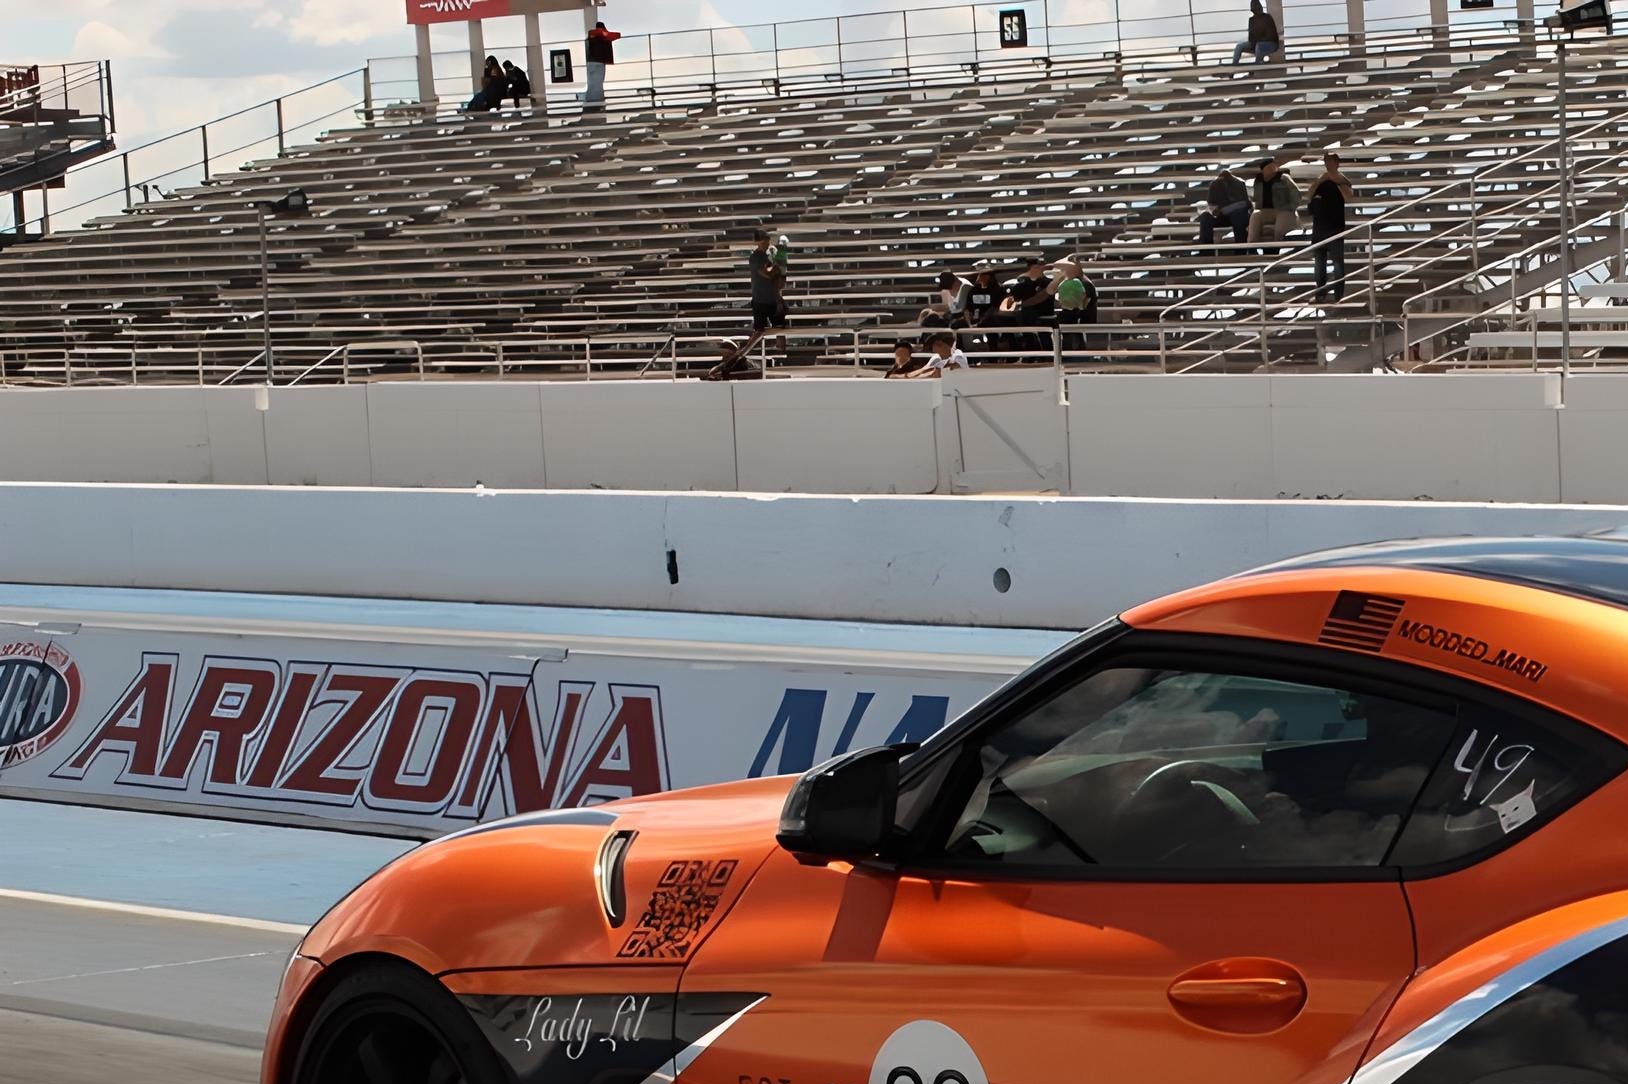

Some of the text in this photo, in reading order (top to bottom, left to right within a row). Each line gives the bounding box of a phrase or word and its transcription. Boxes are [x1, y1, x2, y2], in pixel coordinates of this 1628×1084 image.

[50, 651, 672, 820] ARIZONA
[1454, 728, 1535, 806] 49
[514, 996, 592, 1060] Lady
